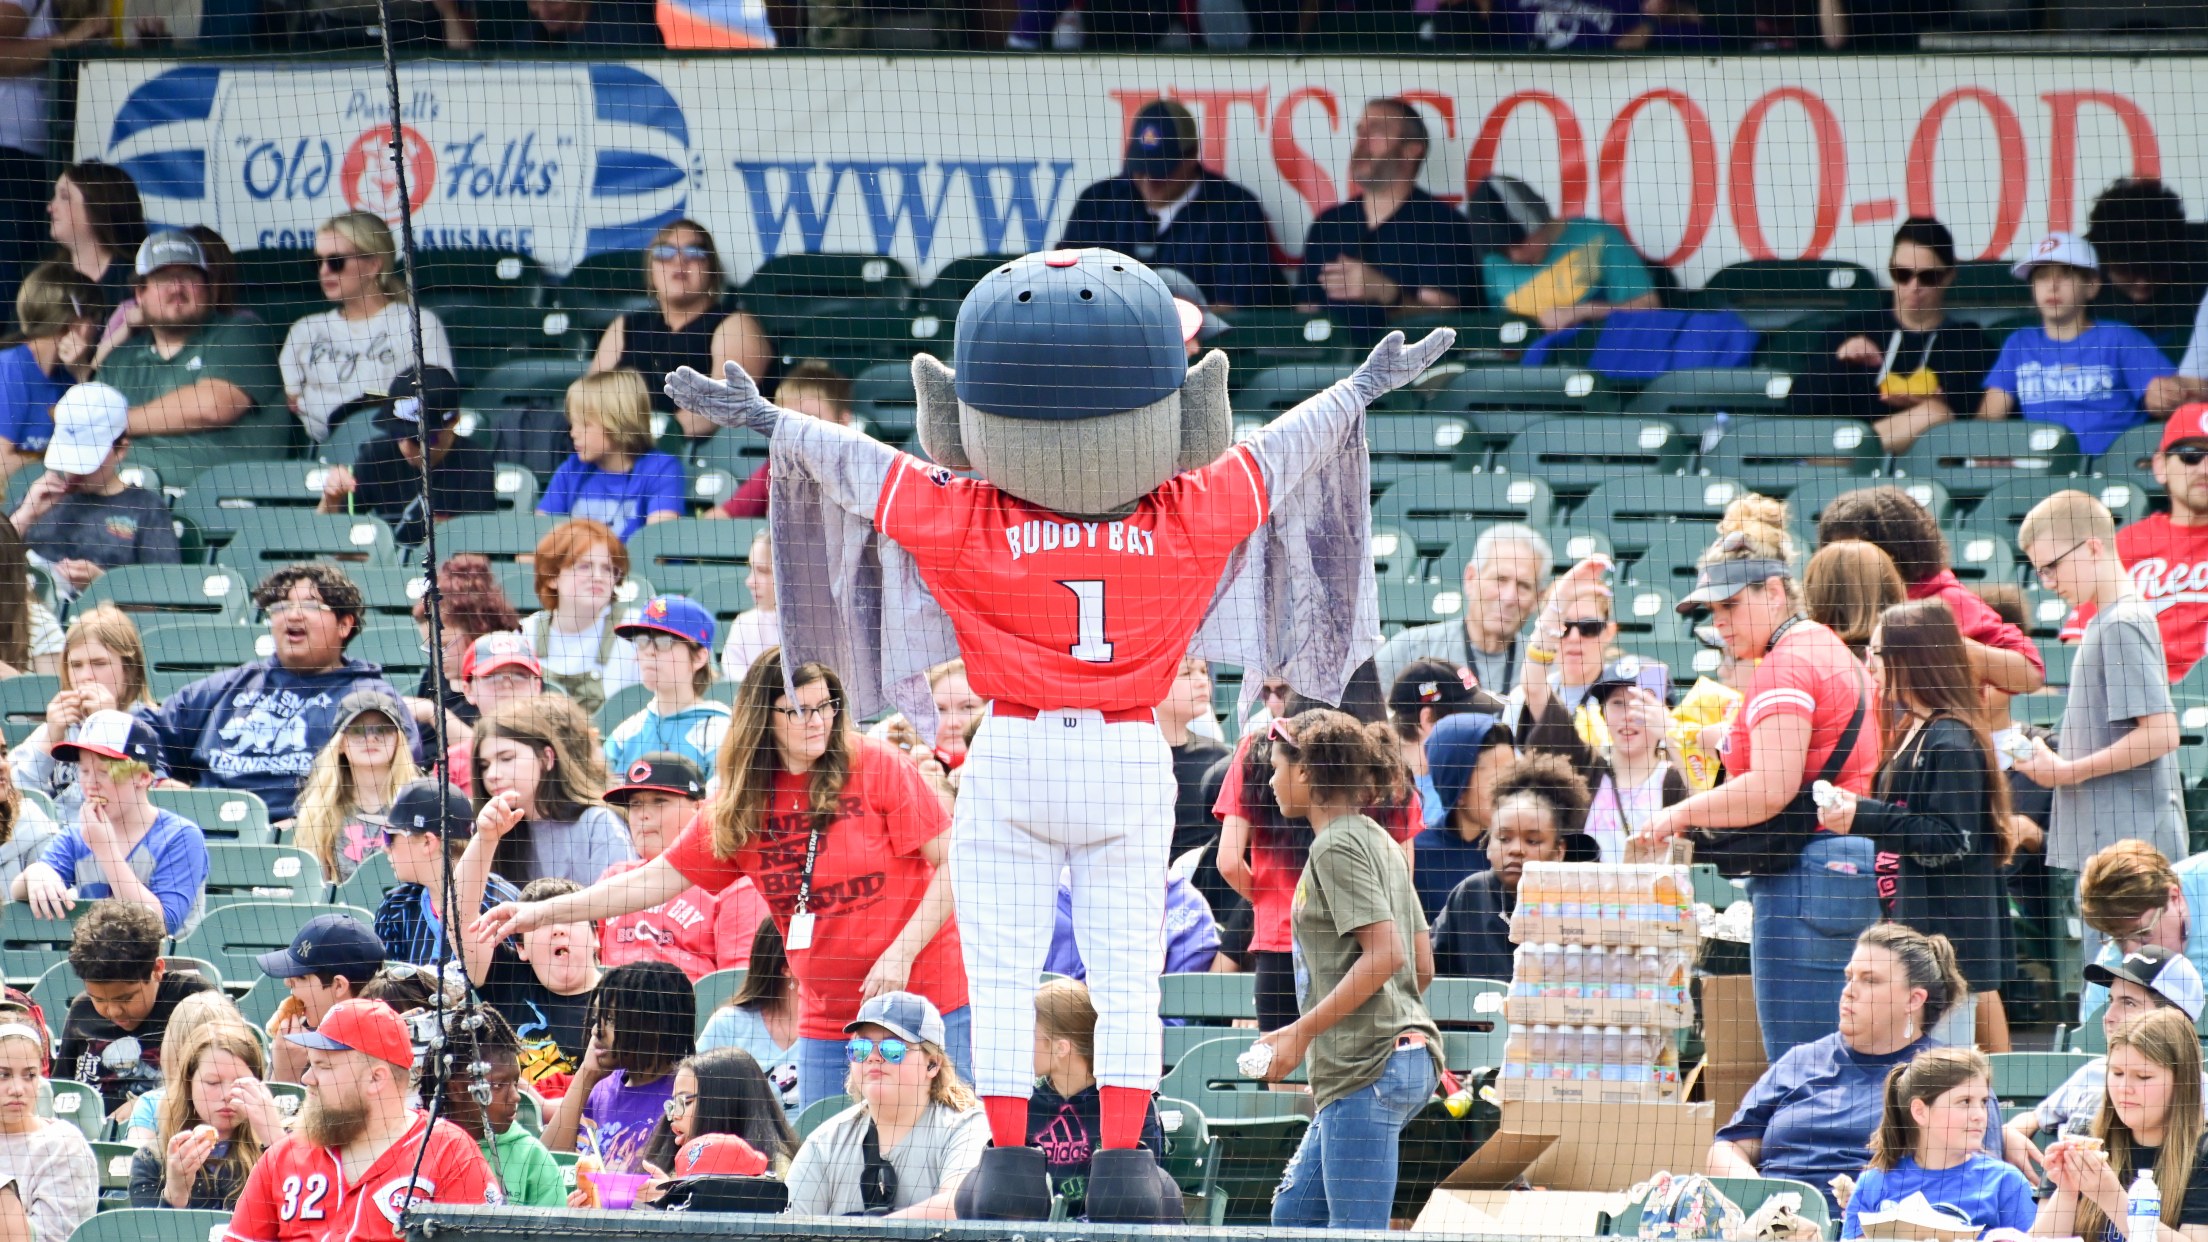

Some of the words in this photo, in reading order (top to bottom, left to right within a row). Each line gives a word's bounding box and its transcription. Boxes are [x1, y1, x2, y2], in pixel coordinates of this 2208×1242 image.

[344, 91, 441, 121] Purell's
[1005, 519, 1099, 561] BUDDY
[1108, 520, 1155, 557] BAT
[1054, 579, 1115, 663] 1
[209, 749, 314, 779] TENNESSEE
[667, 898, 705, 930] DAY
[1043, 1142, 1091, 1164] didas
[280, 1173, 329, 1222] 32
